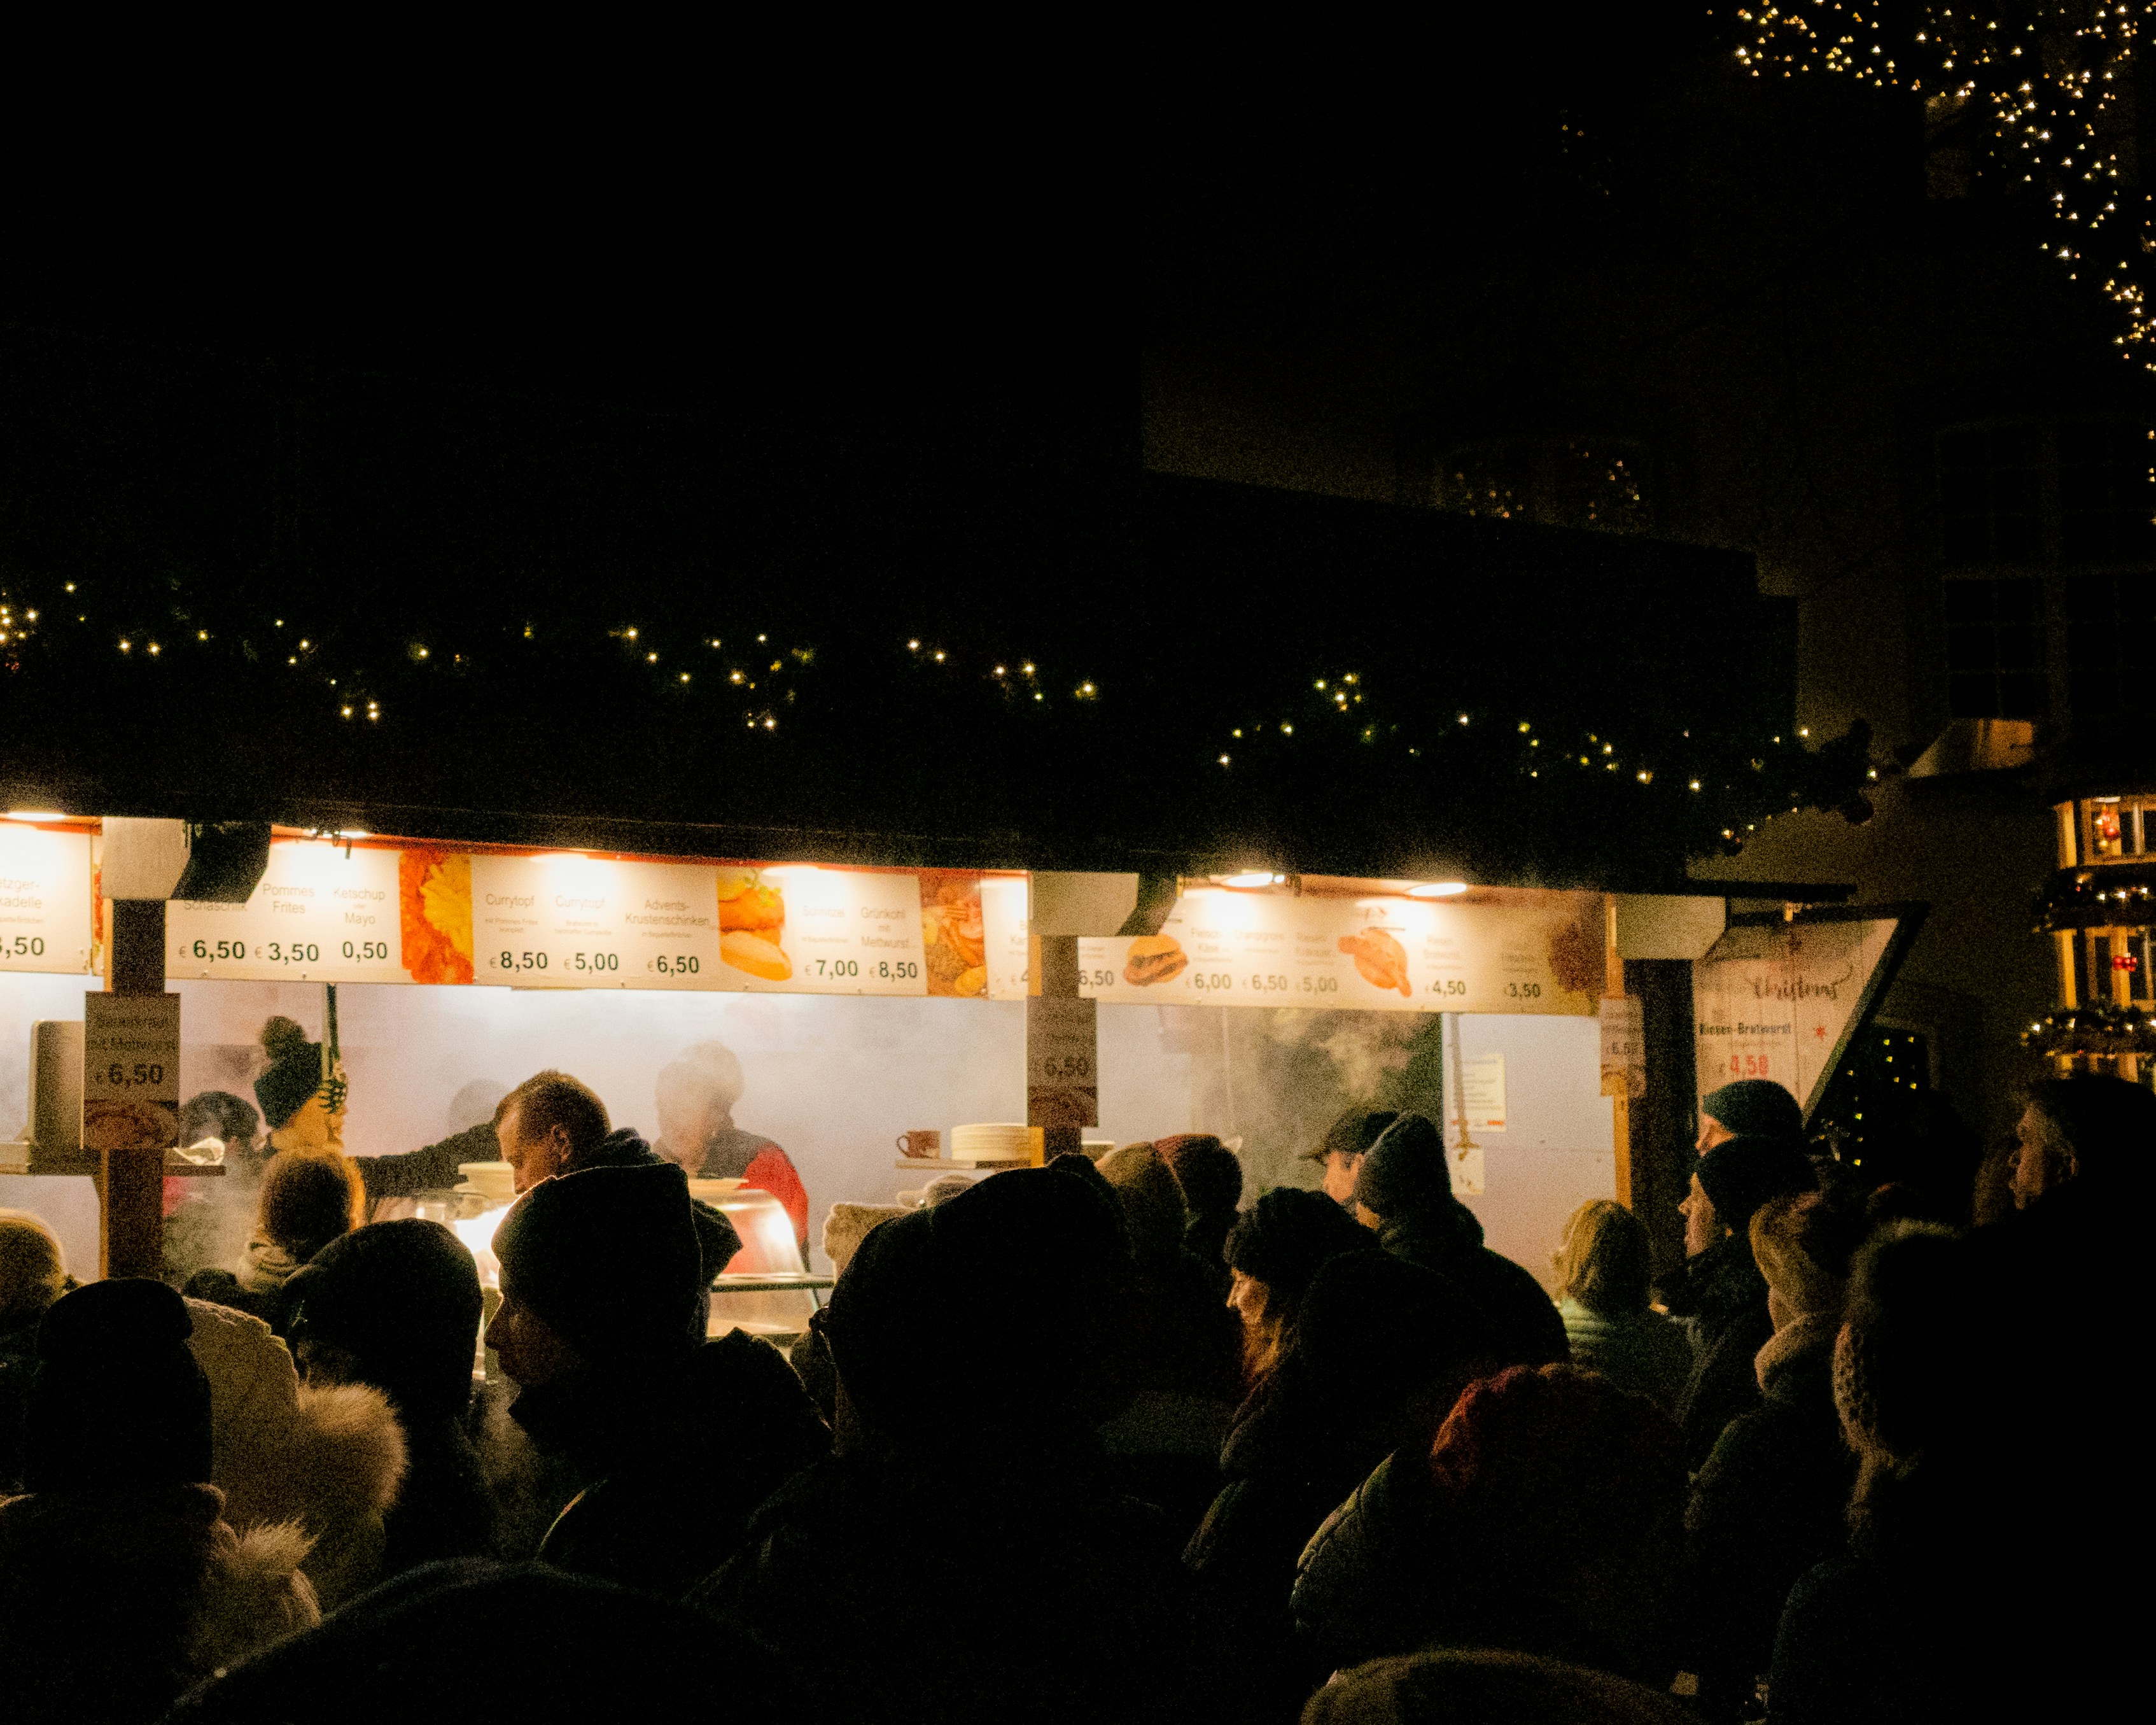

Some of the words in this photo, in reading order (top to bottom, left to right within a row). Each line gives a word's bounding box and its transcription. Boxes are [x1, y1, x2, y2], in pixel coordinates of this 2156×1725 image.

[263, 884, 314, 897] Pommes
[333, 888, 385, 902] Ketschup
[273, 901, 305, 913] Frites
[486, 894, 535, 908] Currytopf
[556, 895, 605, 910] Currytopf
[645, 899, 690, 911] Advents-
[345, 912, 375, 927] Mayo
[625, 913, 709, 926] Krustenschinken
[0, 936, 45, 959] ,50
[193, 940, 246, 962] 6,50
[268, 942, 319, 965] 3,50
[342, 941, 388, 962] 0,50
[500, 951, 549, 972] 8,50
[575, 952, 619, 974] 5,00
[657, 955, 700, 977] 6,50
[815, 959, 859, 980] 7,00
[879, 961, 918, 982] 8,50
[1194, 973, 1232, 992] 6,00
[1252, 975, 1288, 994] 6,50
[1302, 976, 1338, 996] 5,00
[1432, 980, 1466, 997] 4,50
[1509, 983, 1541, 1001] 3,50
[109, 1064, 164, 1089] 6,50
[1044, 1056, 1089, 1081] 6,50
